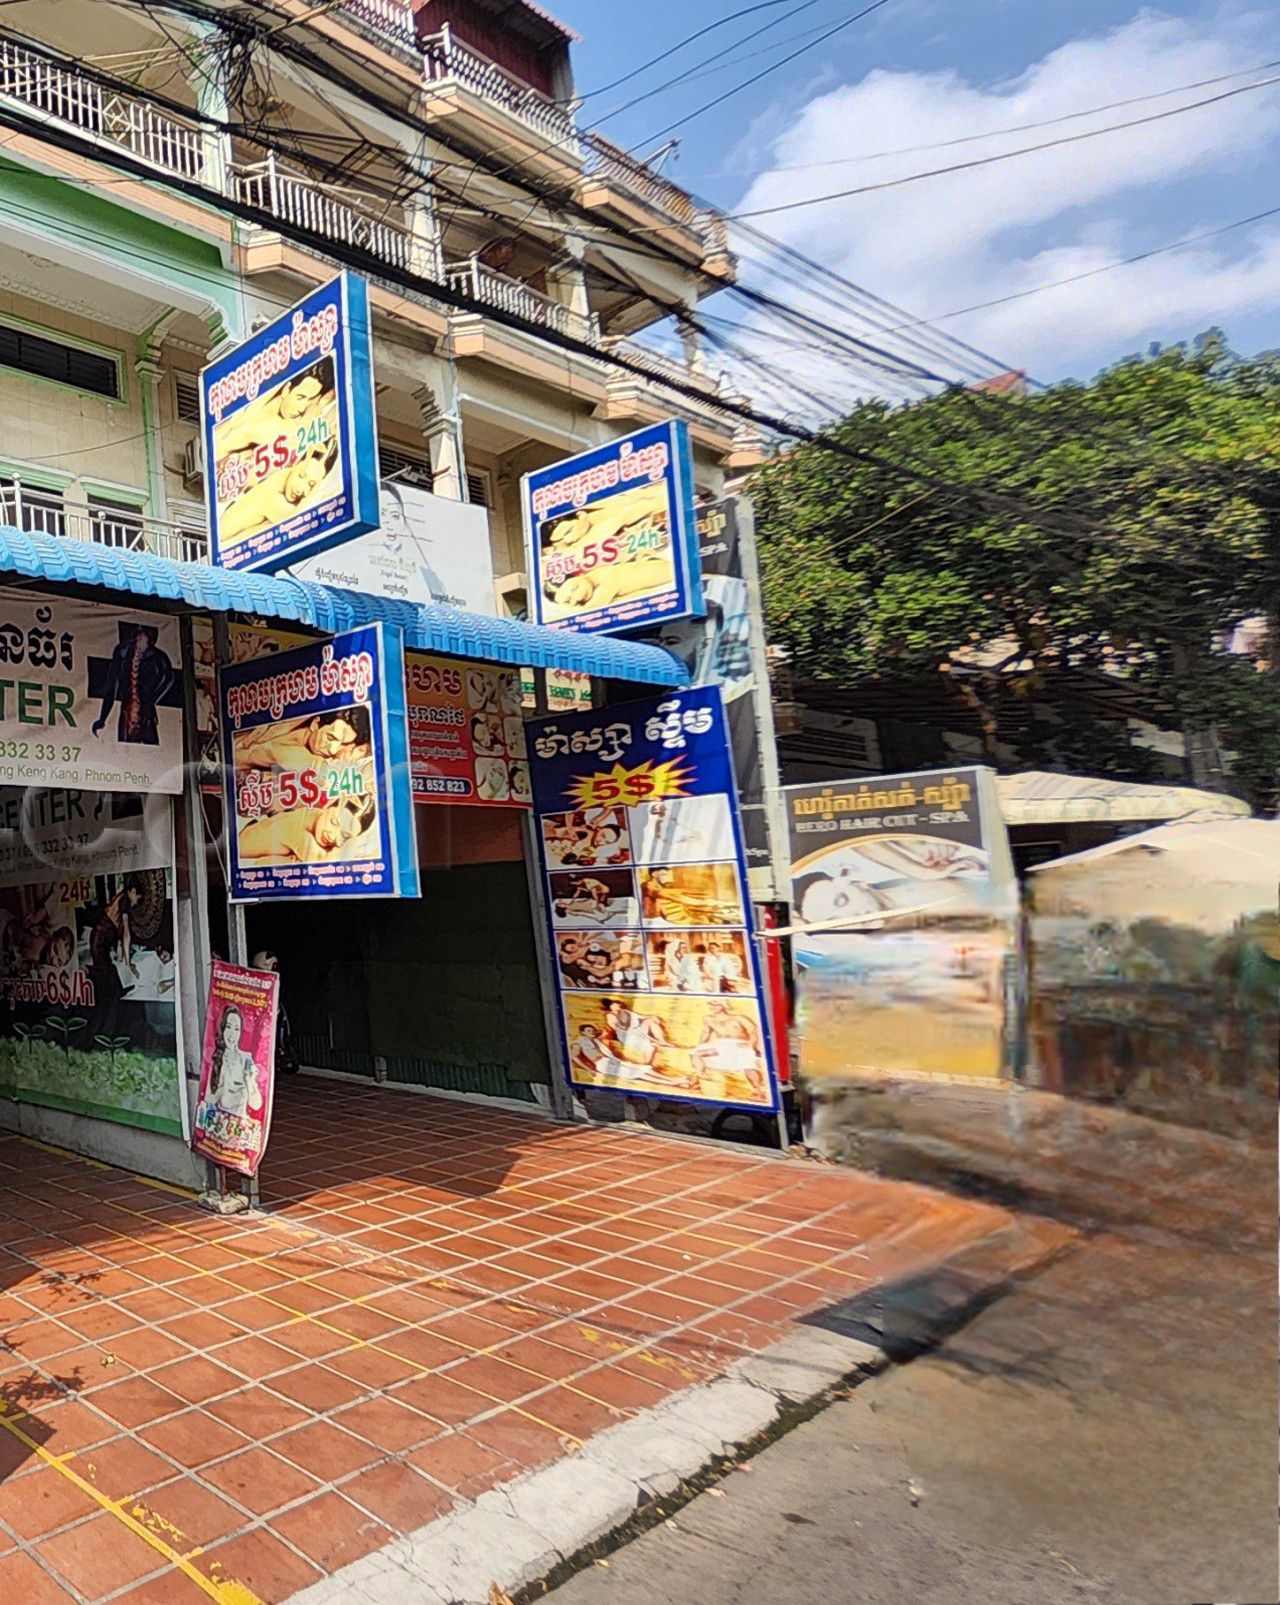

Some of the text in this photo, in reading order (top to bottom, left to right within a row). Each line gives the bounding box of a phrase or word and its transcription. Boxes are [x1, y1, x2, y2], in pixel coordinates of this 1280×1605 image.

[297, 417, 328, 452] 24h
[627, 529, 659, 554] 24h
[35, 744, 55, 761] 33
[62, 745, 81, 762] 37
[17, 765, 46, 781] Keng
[85, 769, 121, 783] Phnom
[426, 779, 445, 792] 852
[447, 780, 465, 793] 823
[279, 768, 319, 809] 5$
[328, 767, 363, 797] 24h
[592, 773, 656, 801] 5$
[796, 821, 838, 833] HERO
[840, 817, 882, 830] HAIR
[883, 814, 919, 827] CUT
[929, 811, 969, 824] SPA
[60, 878, 89, 903] 24h
[46, 969, 95, 1007] 6$/h
